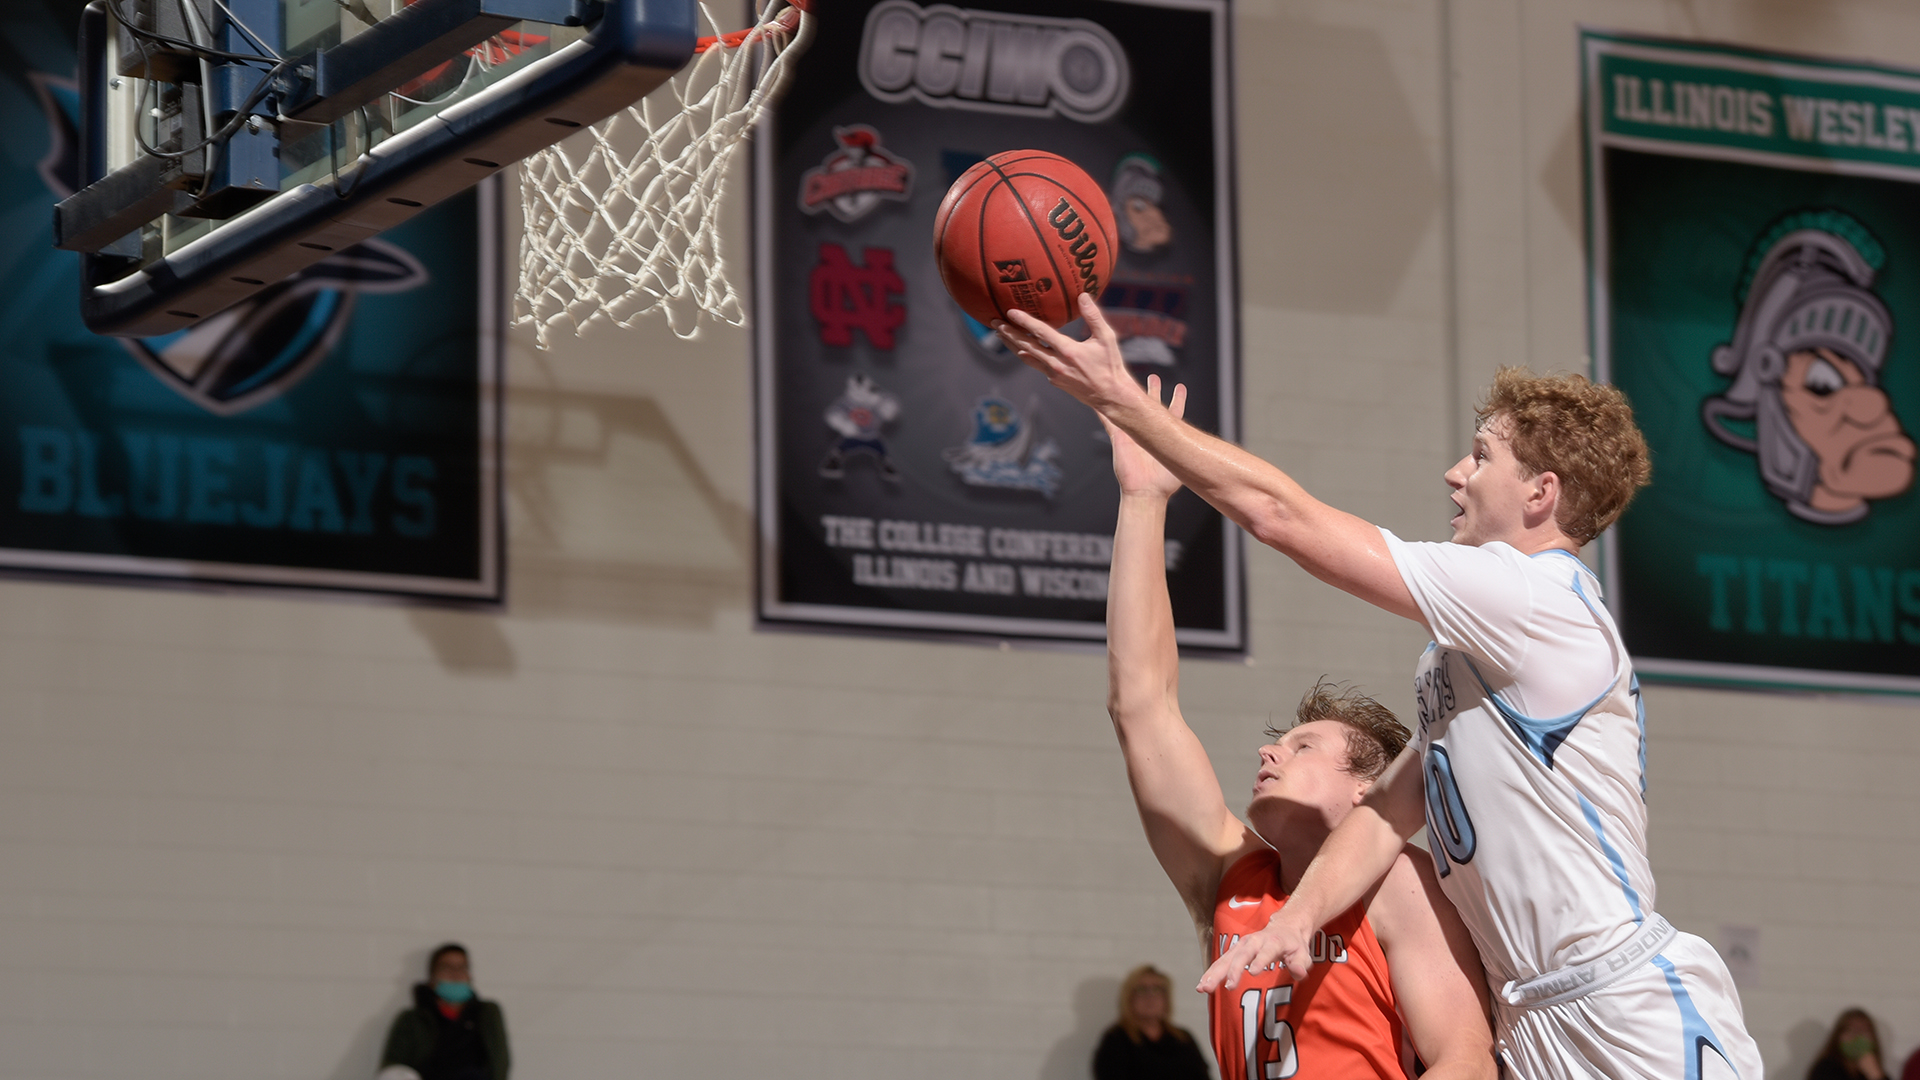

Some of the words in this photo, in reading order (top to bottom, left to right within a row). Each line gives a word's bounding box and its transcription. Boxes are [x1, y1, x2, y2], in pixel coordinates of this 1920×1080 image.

[1612, 73, 1775, 138] ILLINOIS
[1047, 196, 1099, 299] Wilso
[18, 425, 438, 538] BLUEJAYS
[821, 515, 875, 549] THE
[879, 519, 986, 557] COLLEGE
[989, 527, 1114, 566] CONFEREN
[852, 554, 957, 591] ILLINOIS
[962, 561, 1015, 595] AND
[1020, 565, 1110, 600] WISCON
[1518, 965, 1596, 1000] ARMO
[1240, 984, 1299, 1080] 15
